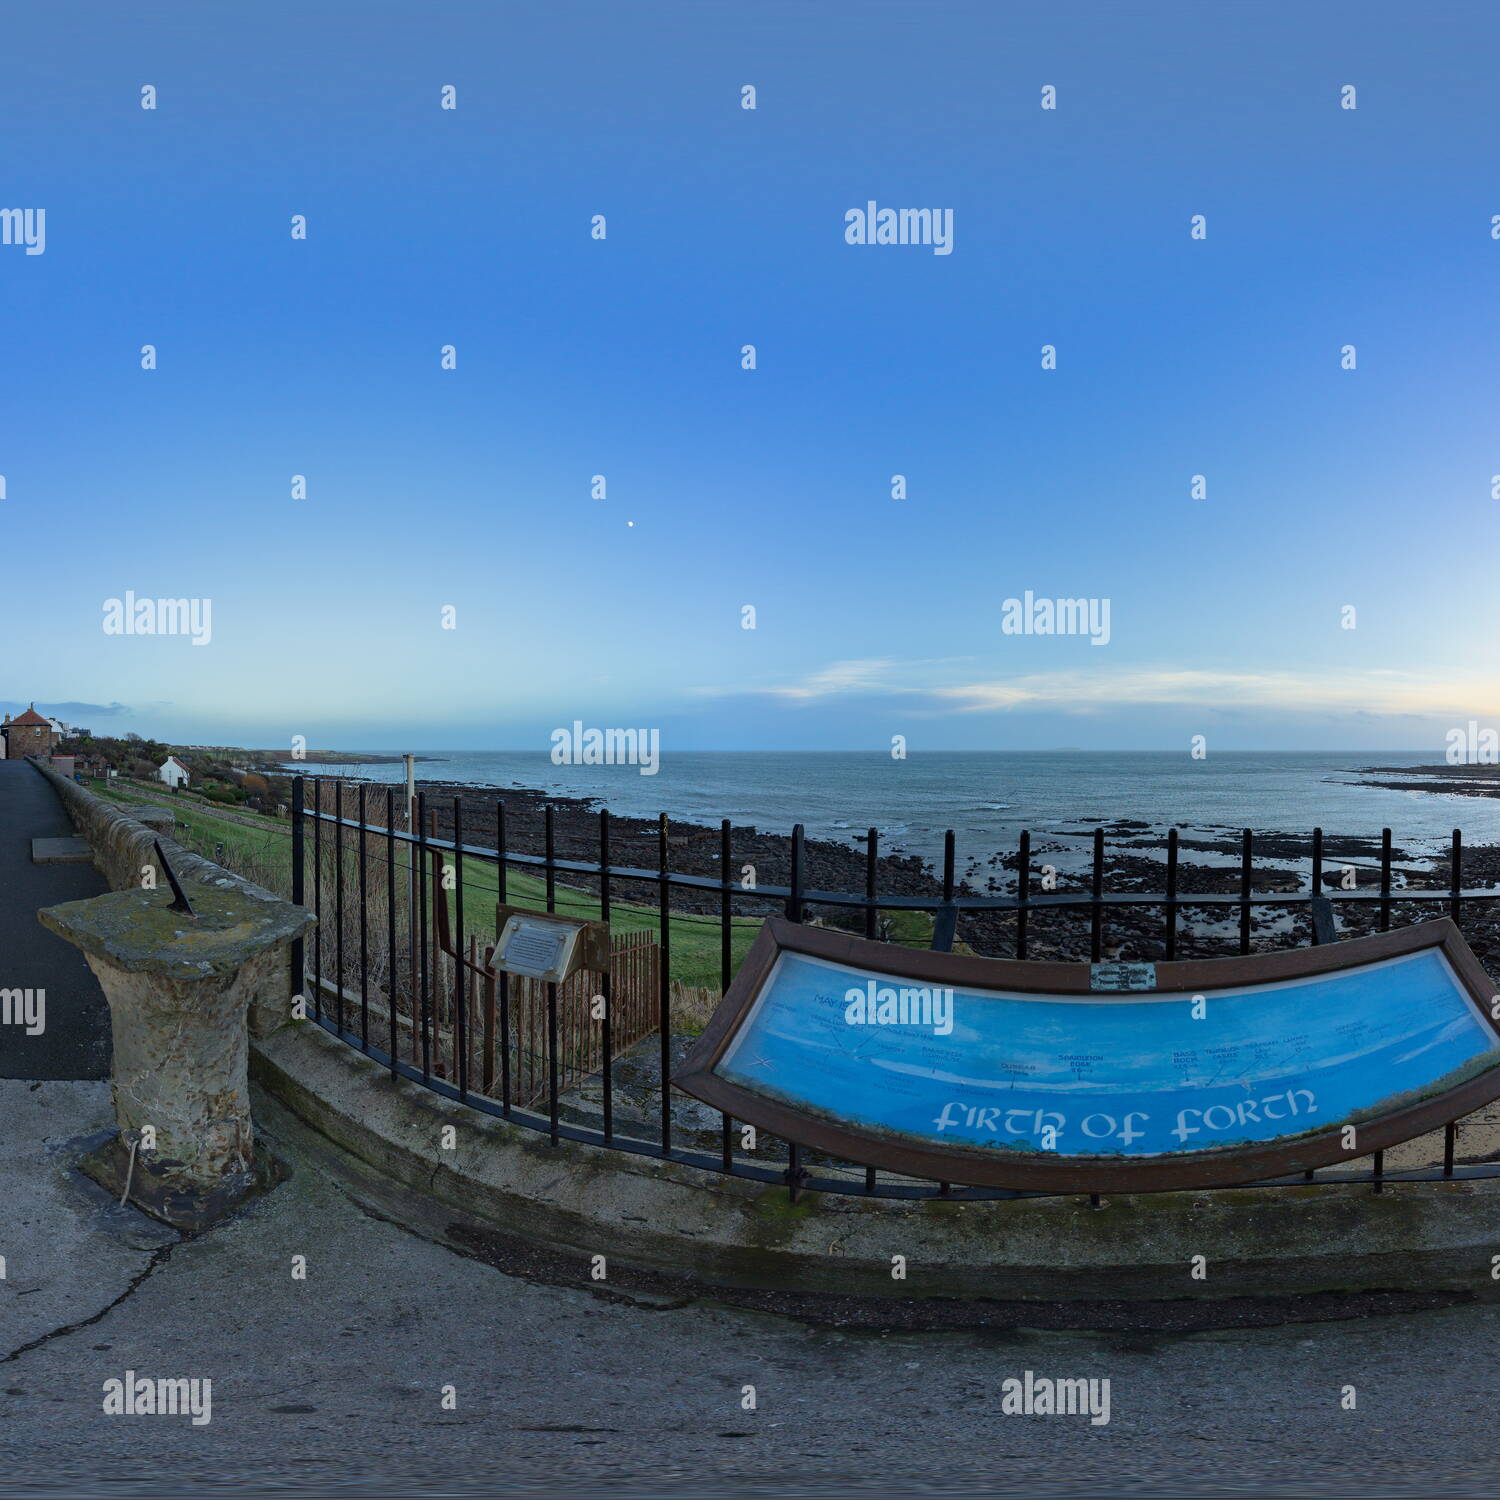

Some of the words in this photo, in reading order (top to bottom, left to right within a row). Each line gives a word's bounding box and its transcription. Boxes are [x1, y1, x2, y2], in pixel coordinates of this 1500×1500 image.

[931, 1101, 1066, 1137] FIRTH
[1081, 1111, 1150, 1147] OF
[1170, 1088, 1319, 1143] FORTH
